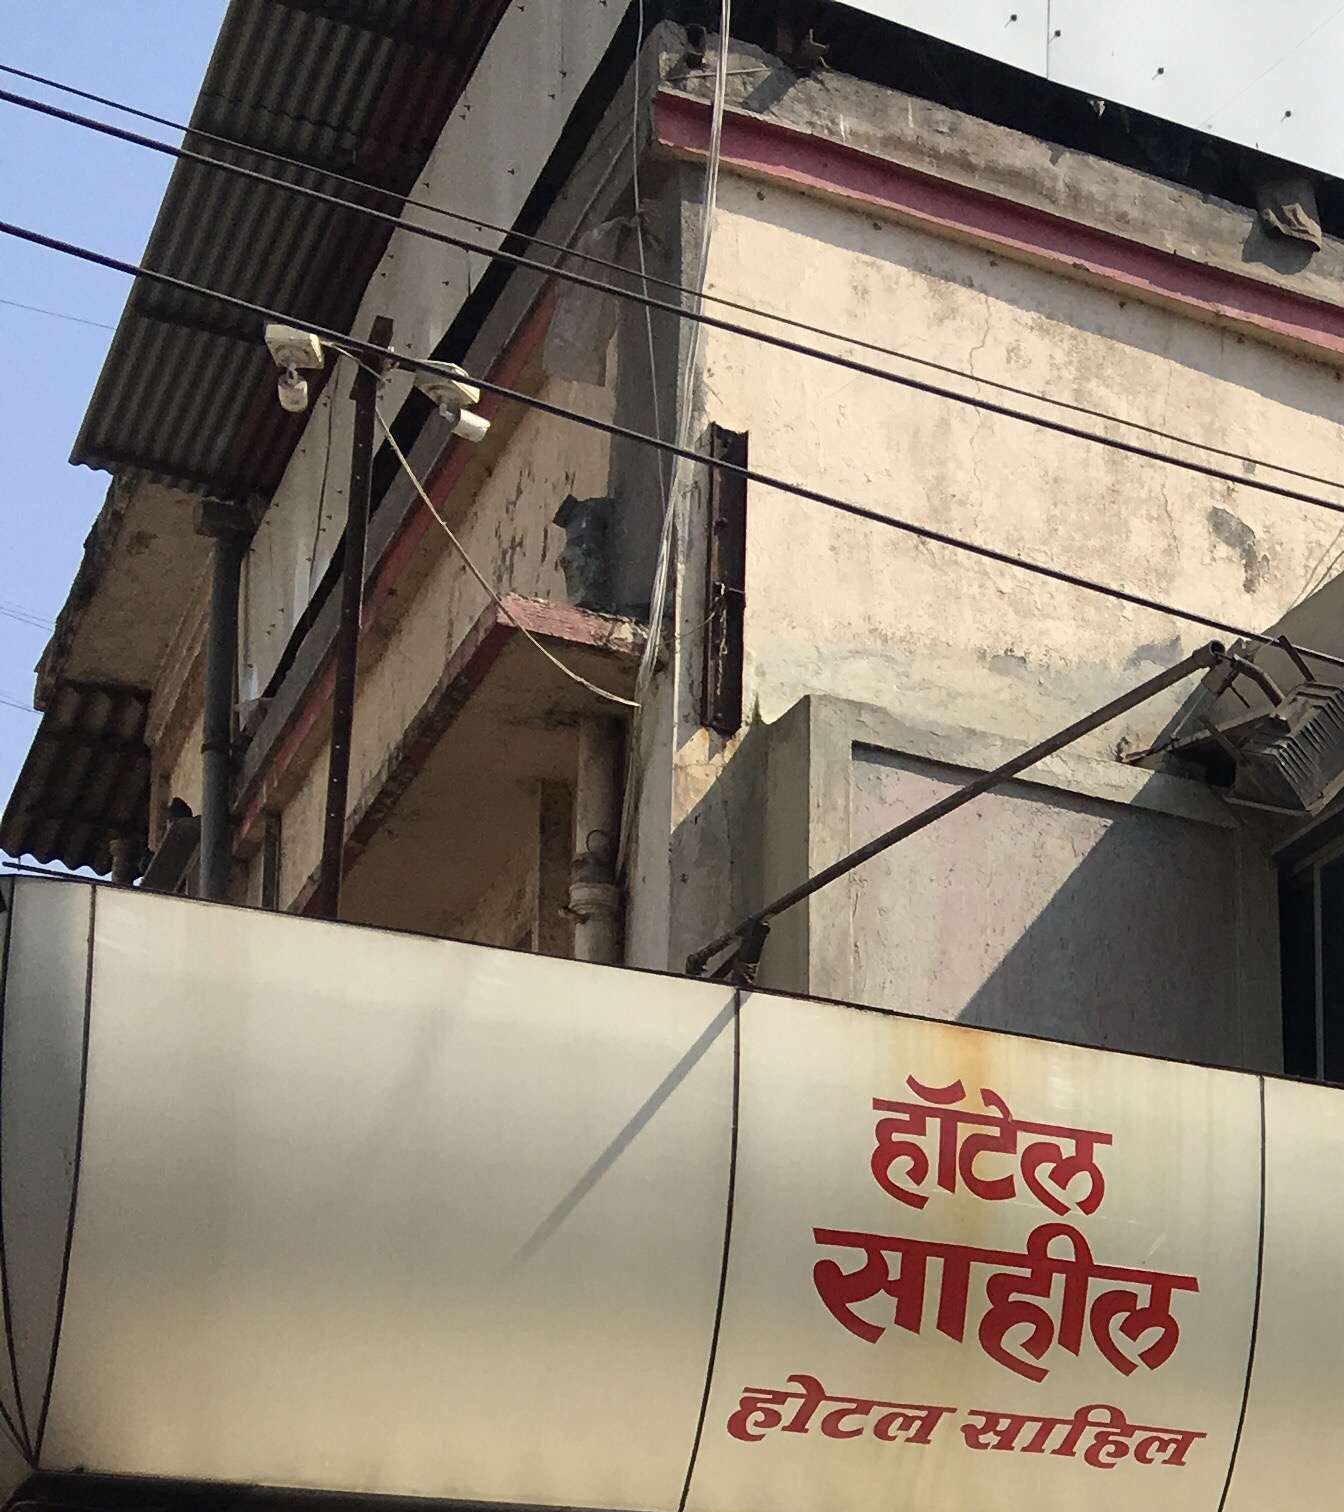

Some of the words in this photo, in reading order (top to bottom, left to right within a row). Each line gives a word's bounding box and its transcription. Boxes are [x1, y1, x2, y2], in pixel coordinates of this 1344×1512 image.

[871, 1074, 1113, 1217] हॉटेल
[812, 1222, 1199, 1383] साहील
[727, 1375, 958, 1446] होटल
[960, 1405, 1207, 1469] साहिल
